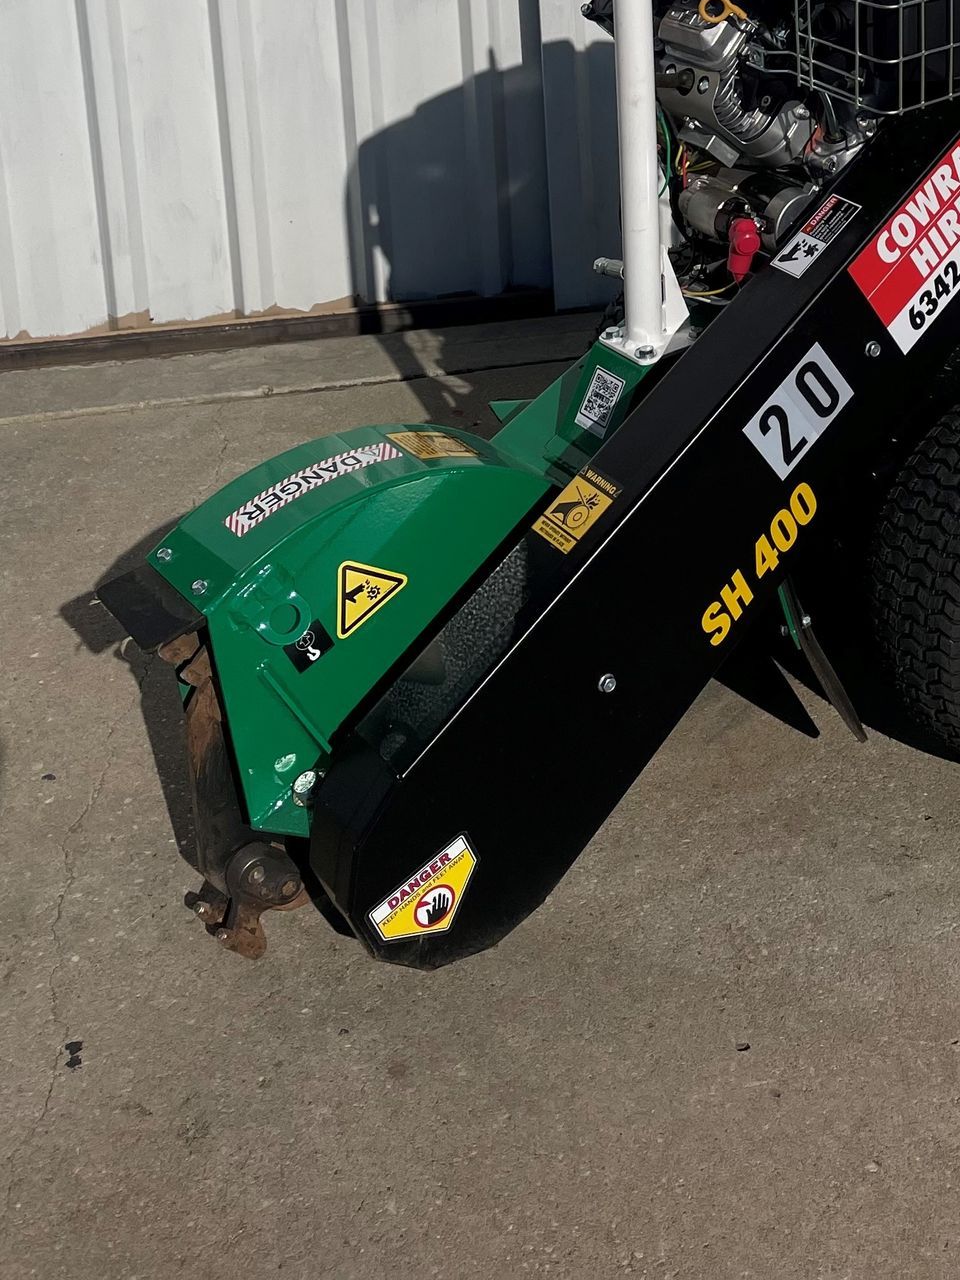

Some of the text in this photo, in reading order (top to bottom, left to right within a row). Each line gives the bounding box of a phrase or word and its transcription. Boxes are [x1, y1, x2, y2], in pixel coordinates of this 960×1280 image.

[810, 197, 839, 226] DANGER
[758, 360, 840, 467] 20
[240, 455, 362, 521] DANGER
[585, 469, 617, 495] WARNING
[701, 482, 817, 646] SH 400
[382, 911, 399, 927] KEEP
[399, 893, 421, 912] HANDS
[432, 868, 448, 884] FEET
[448, 853, 465, 870] AWAY
[387, 852, 452, 911] DANGER
